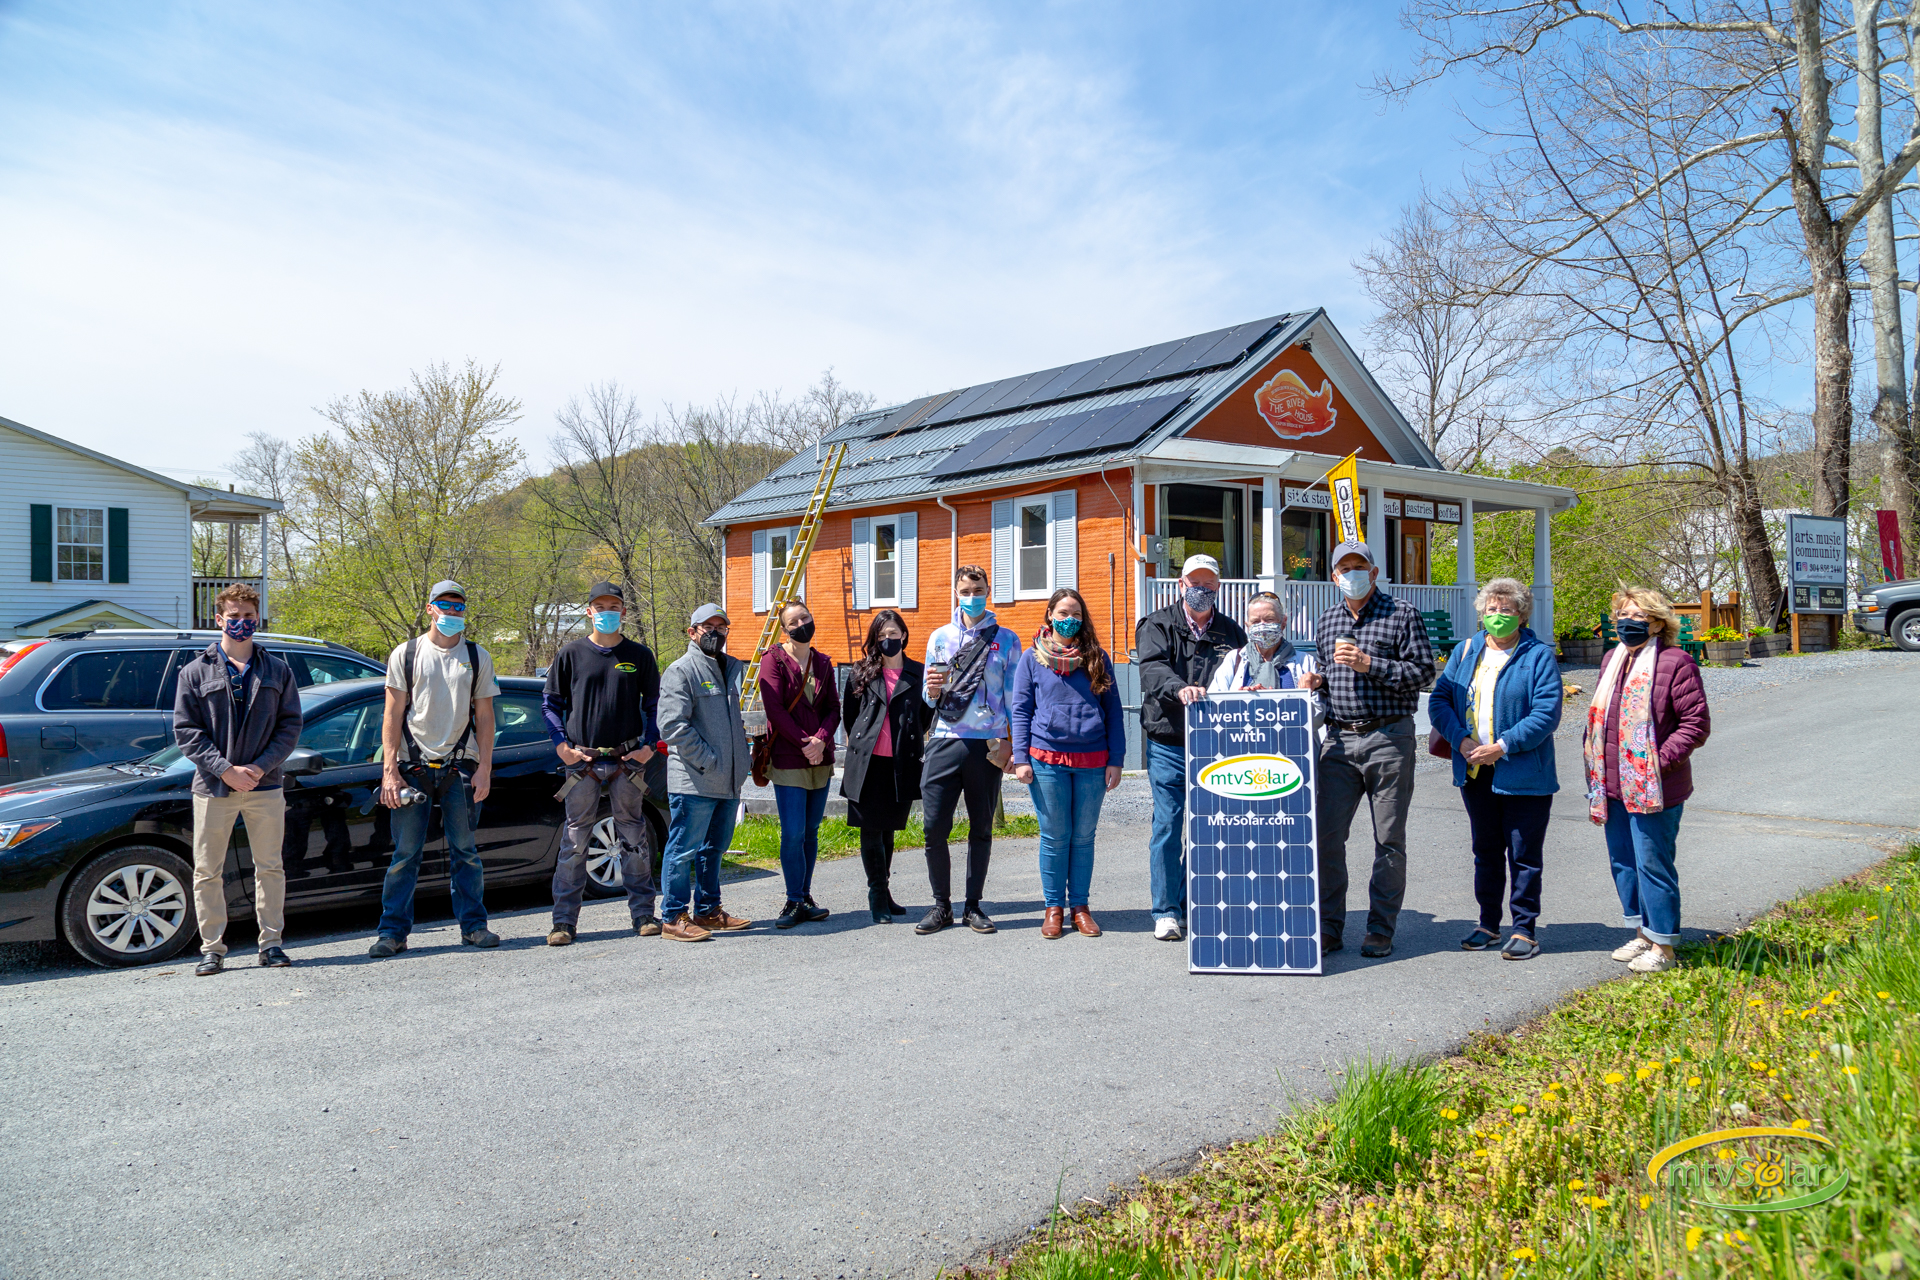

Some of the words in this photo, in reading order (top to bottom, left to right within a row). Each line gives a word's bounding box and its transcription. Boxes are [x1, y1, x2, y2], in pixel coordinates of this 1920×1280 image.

[1269, 402, 1285, 413] THE
[1286, 398, 1305, 408] RIVER
[1295, 409, 1314, 421] HOUSE
[1287, 489, 1300, 503] sit
[1301, 491, 1310, 504] &
[1311, 492, 1331, 508] stay
[1339, 485, 1355, 541] OPE
[1383, 501, 1400, 515] cafe
[1406, 503, 1433, 515] pastries
[1438, 507, 1459, 520] coffee
[1816, 531, 1843, 546] music.
[1795, 545, 1843, 562] community.
[1796, 587, 1808, 596] FREE
[1199, 709, 1203, 723] I
[1208, 710, 1250, 723] went
[1255, 706, 1298, 722] Solar
[1229, 727, 1266, 743] with
[1210, 768, 1290, 786] mtvSolar
[1207, 815, 1295, 826] MtvSolar.com
